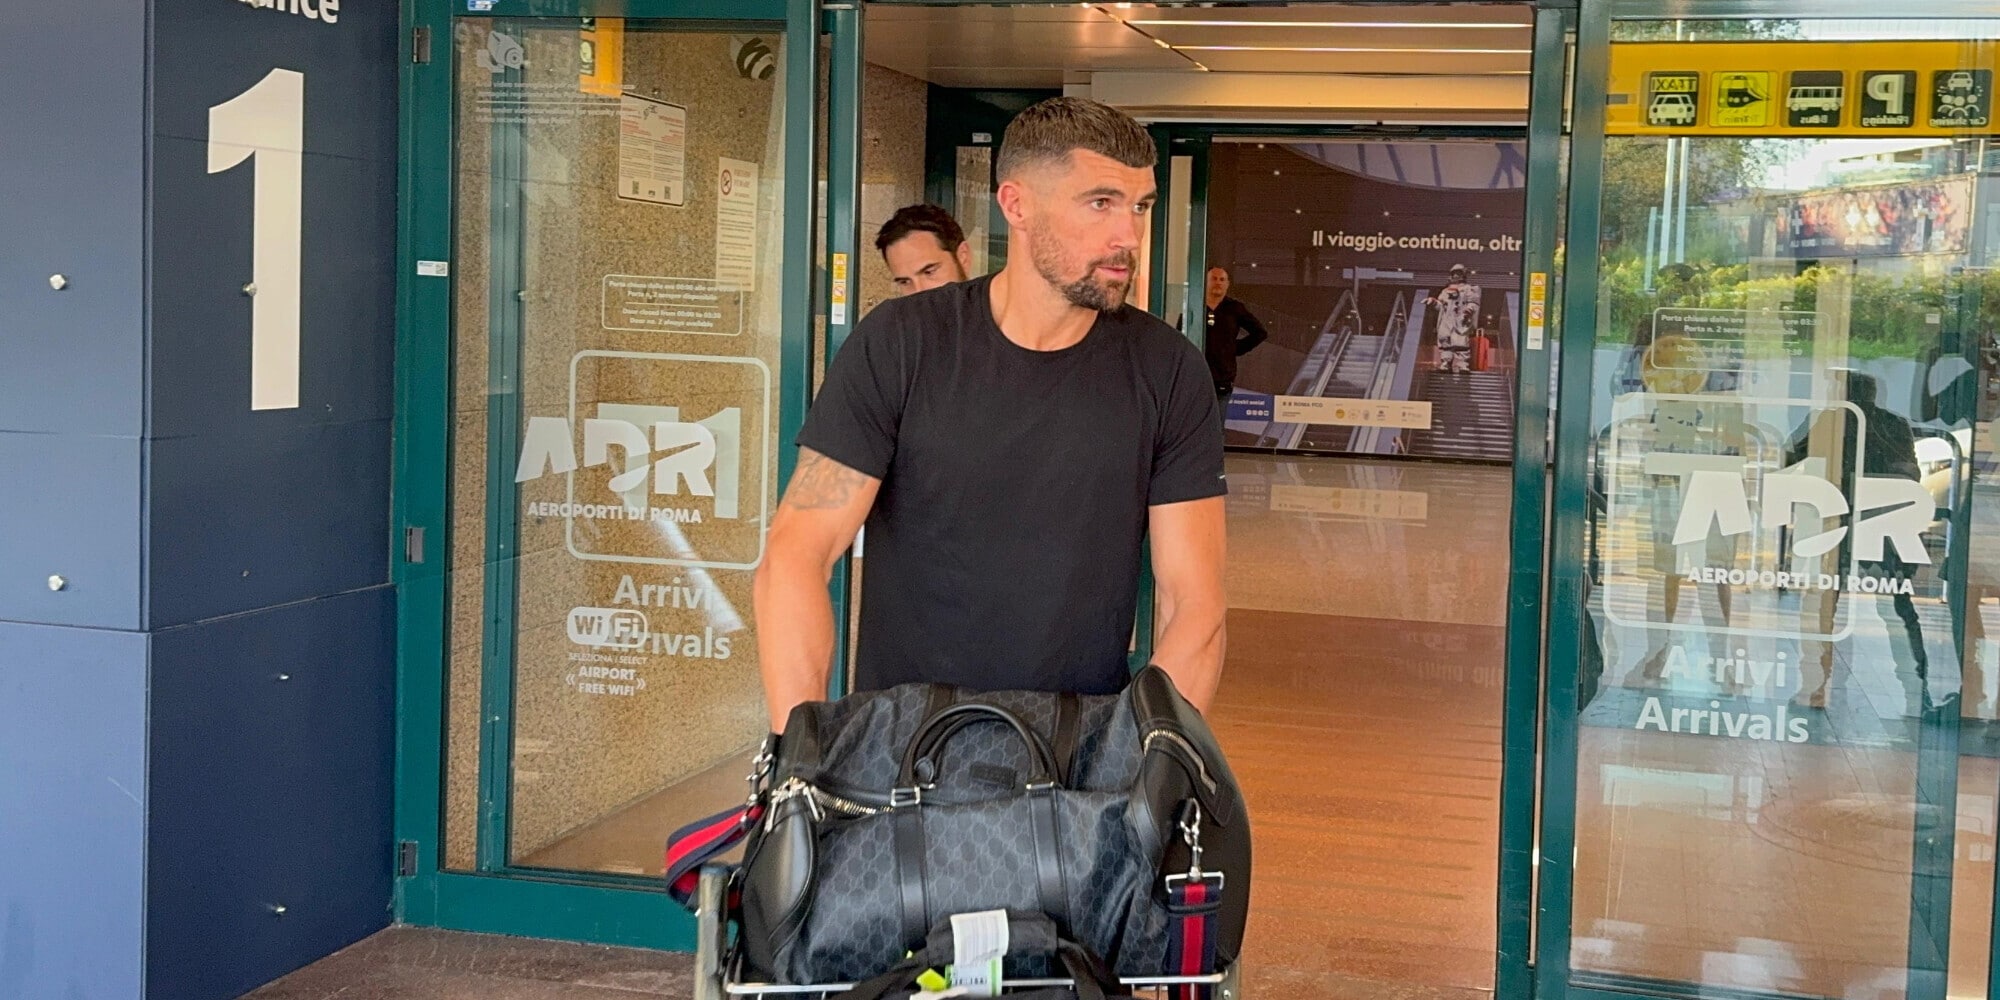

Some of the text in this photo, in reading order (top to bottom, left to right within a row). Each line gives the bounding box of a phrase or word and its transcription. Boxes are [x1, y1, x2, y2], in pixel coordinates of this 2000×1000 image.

[208, 68, 304, 411] 1
[1312, 230, 1523, 252] Il viaggio continua, oltr
[1716, 325, 1721, 333] 2
[514, 416, 716, 497] ADR
[527, 501, 702, 524] AEROPORTI DI ROMA
[1672, 470, 1936, 564] ADR
[1687, 566, 1915, 596] AEROPORTI DI ROMA
[578, 665, 636, 681] AIRPORT
[1660, 645, 1787, 687] Arrivi
[578, 682, 635, 697] FREE WIFI
[1634, 696, 1810, 744] Arrivals
